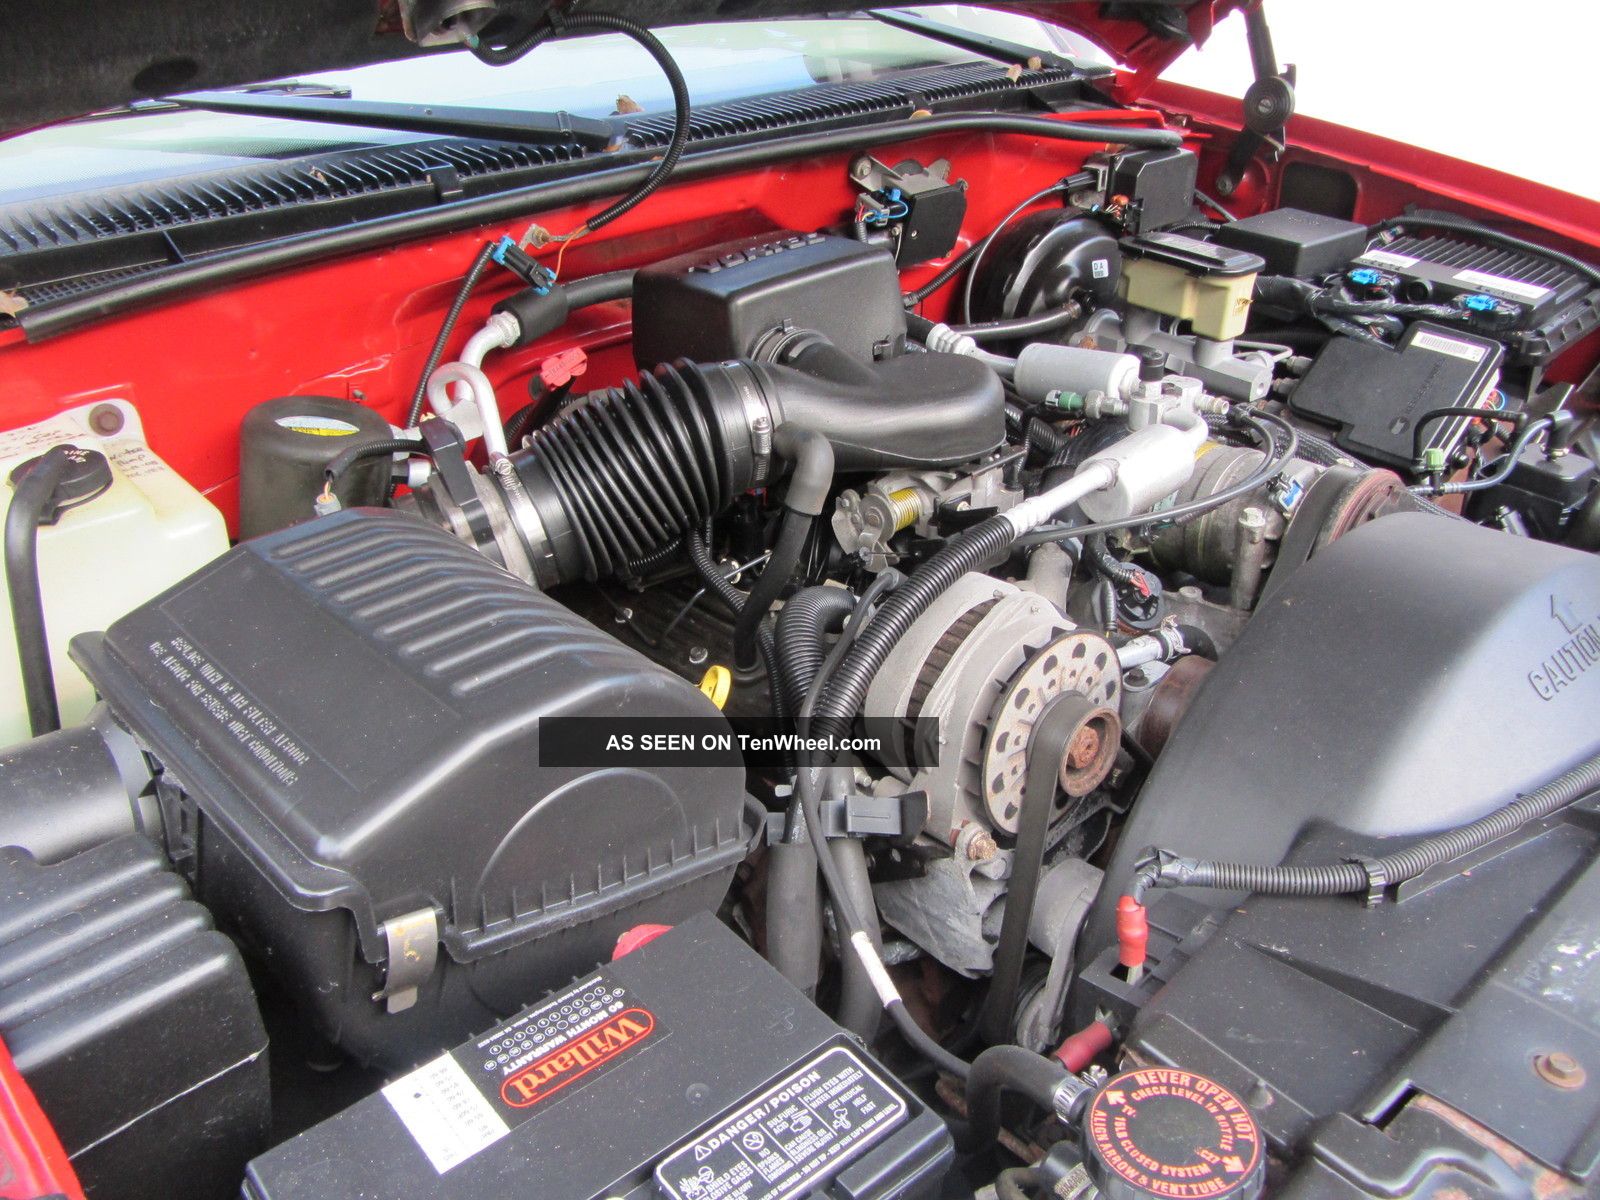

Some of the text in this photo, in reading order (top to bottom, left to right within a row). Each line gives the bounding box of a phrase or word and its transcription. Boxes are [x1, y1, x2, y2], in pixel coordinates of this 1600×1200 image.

[565, 1009, 608, 1038] MONTH
[502, 1034, 566, 1076] WARRANTY
[510, 1017, 647, 1100] Willard
[838, 1083, 864, 1103] MEDICAL
[1135, 1072, 1253, 1143] NEVER OPEN HOT
[707, 1109, 766, 1150] DANGER
[769, 1070, 821, 1108] POISON
[766, 1104, 798, 1128] SULFURIC
[1131, 1086, 1234, 1151] CHECK LEVEL IN BOTTLE
[772, 1120, 789, 1134] ACID
[1094, 1110, 1109, 1142] ALIGN
[758, 1147, 770, 1158] NO
[1100, 1143, 1140, 1179] ARROW
[1121, 1140, 1159, 1172] CLOSED
[1161, 1163, 1212, 1178] SYSTEM
[705, 1160, 748, 1192] SHIELD EYES
[729, 1166, 753, 1185] GASES
[1137, 1173, 1148, 1186] &
[1152, 1178, 1191, 1195] VENT
[1189, 1178, 1226, 1195] TUBE
